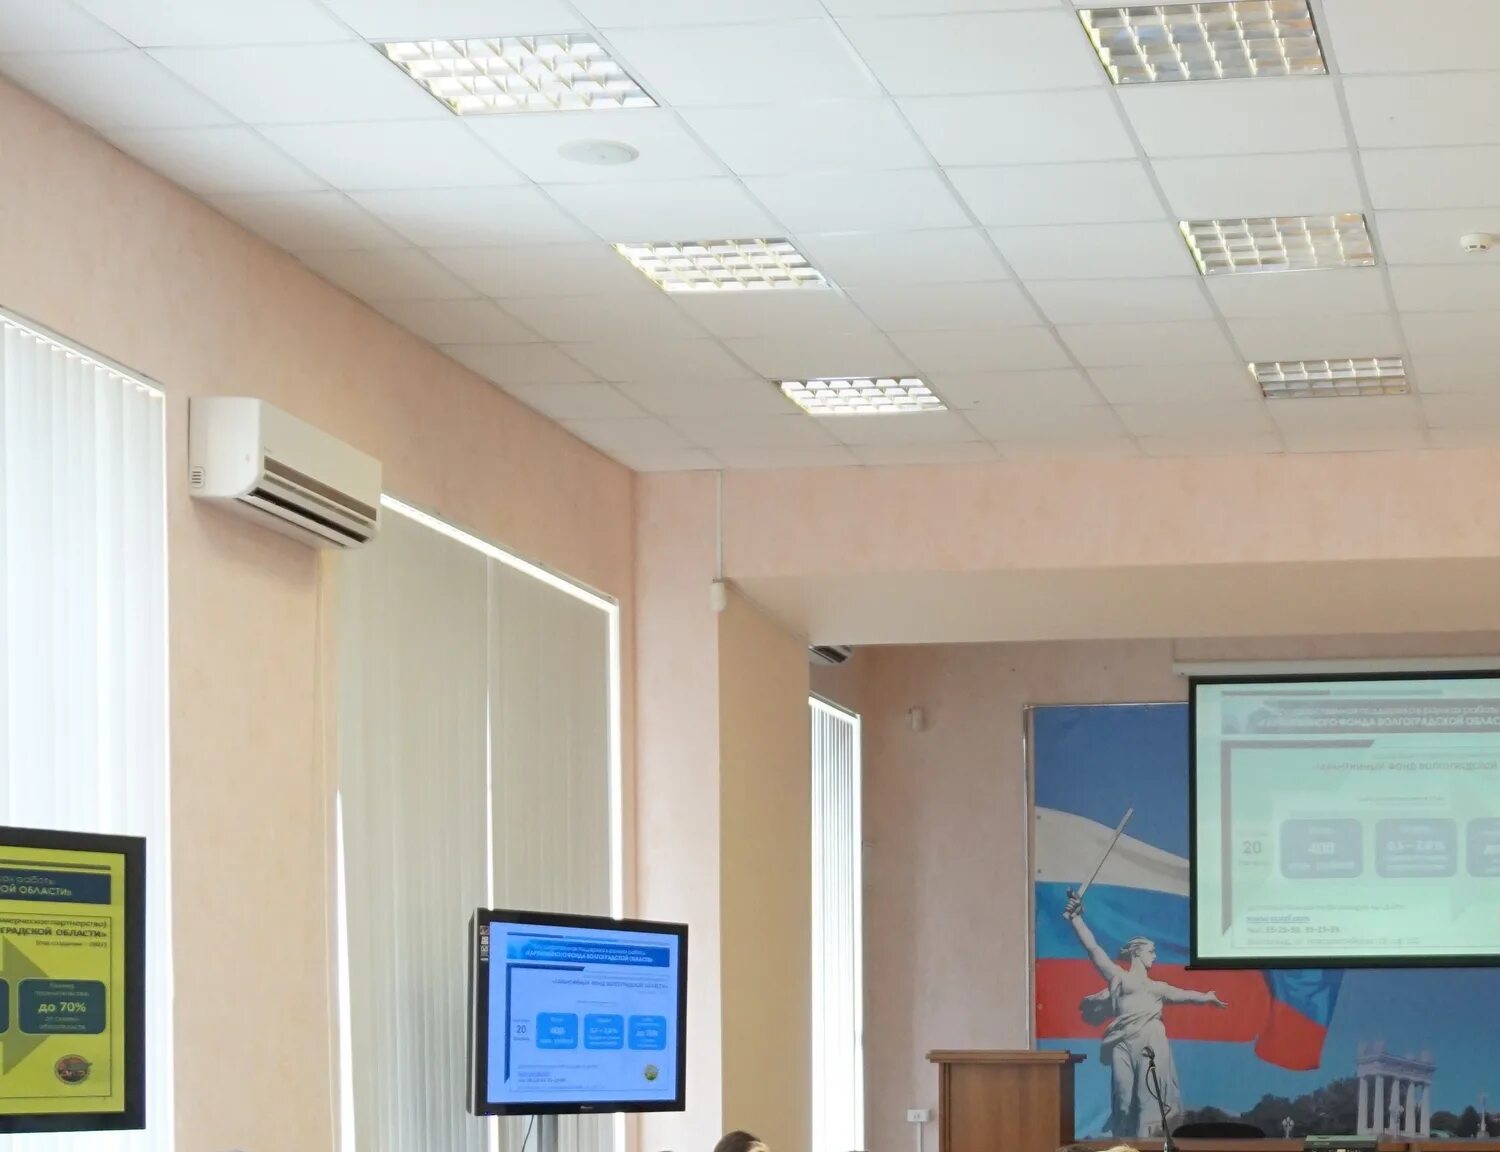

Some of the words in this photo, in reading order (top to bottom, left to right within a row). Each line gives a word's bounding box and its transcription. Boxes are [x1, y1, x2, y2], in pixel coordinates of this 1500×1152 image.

[1242, 840, 1263, 855] 20
[37, 1003, 57, 1014] до
[59, 1001, 87, 1013] 70%
[516, 1024, 527, 1034] 20
